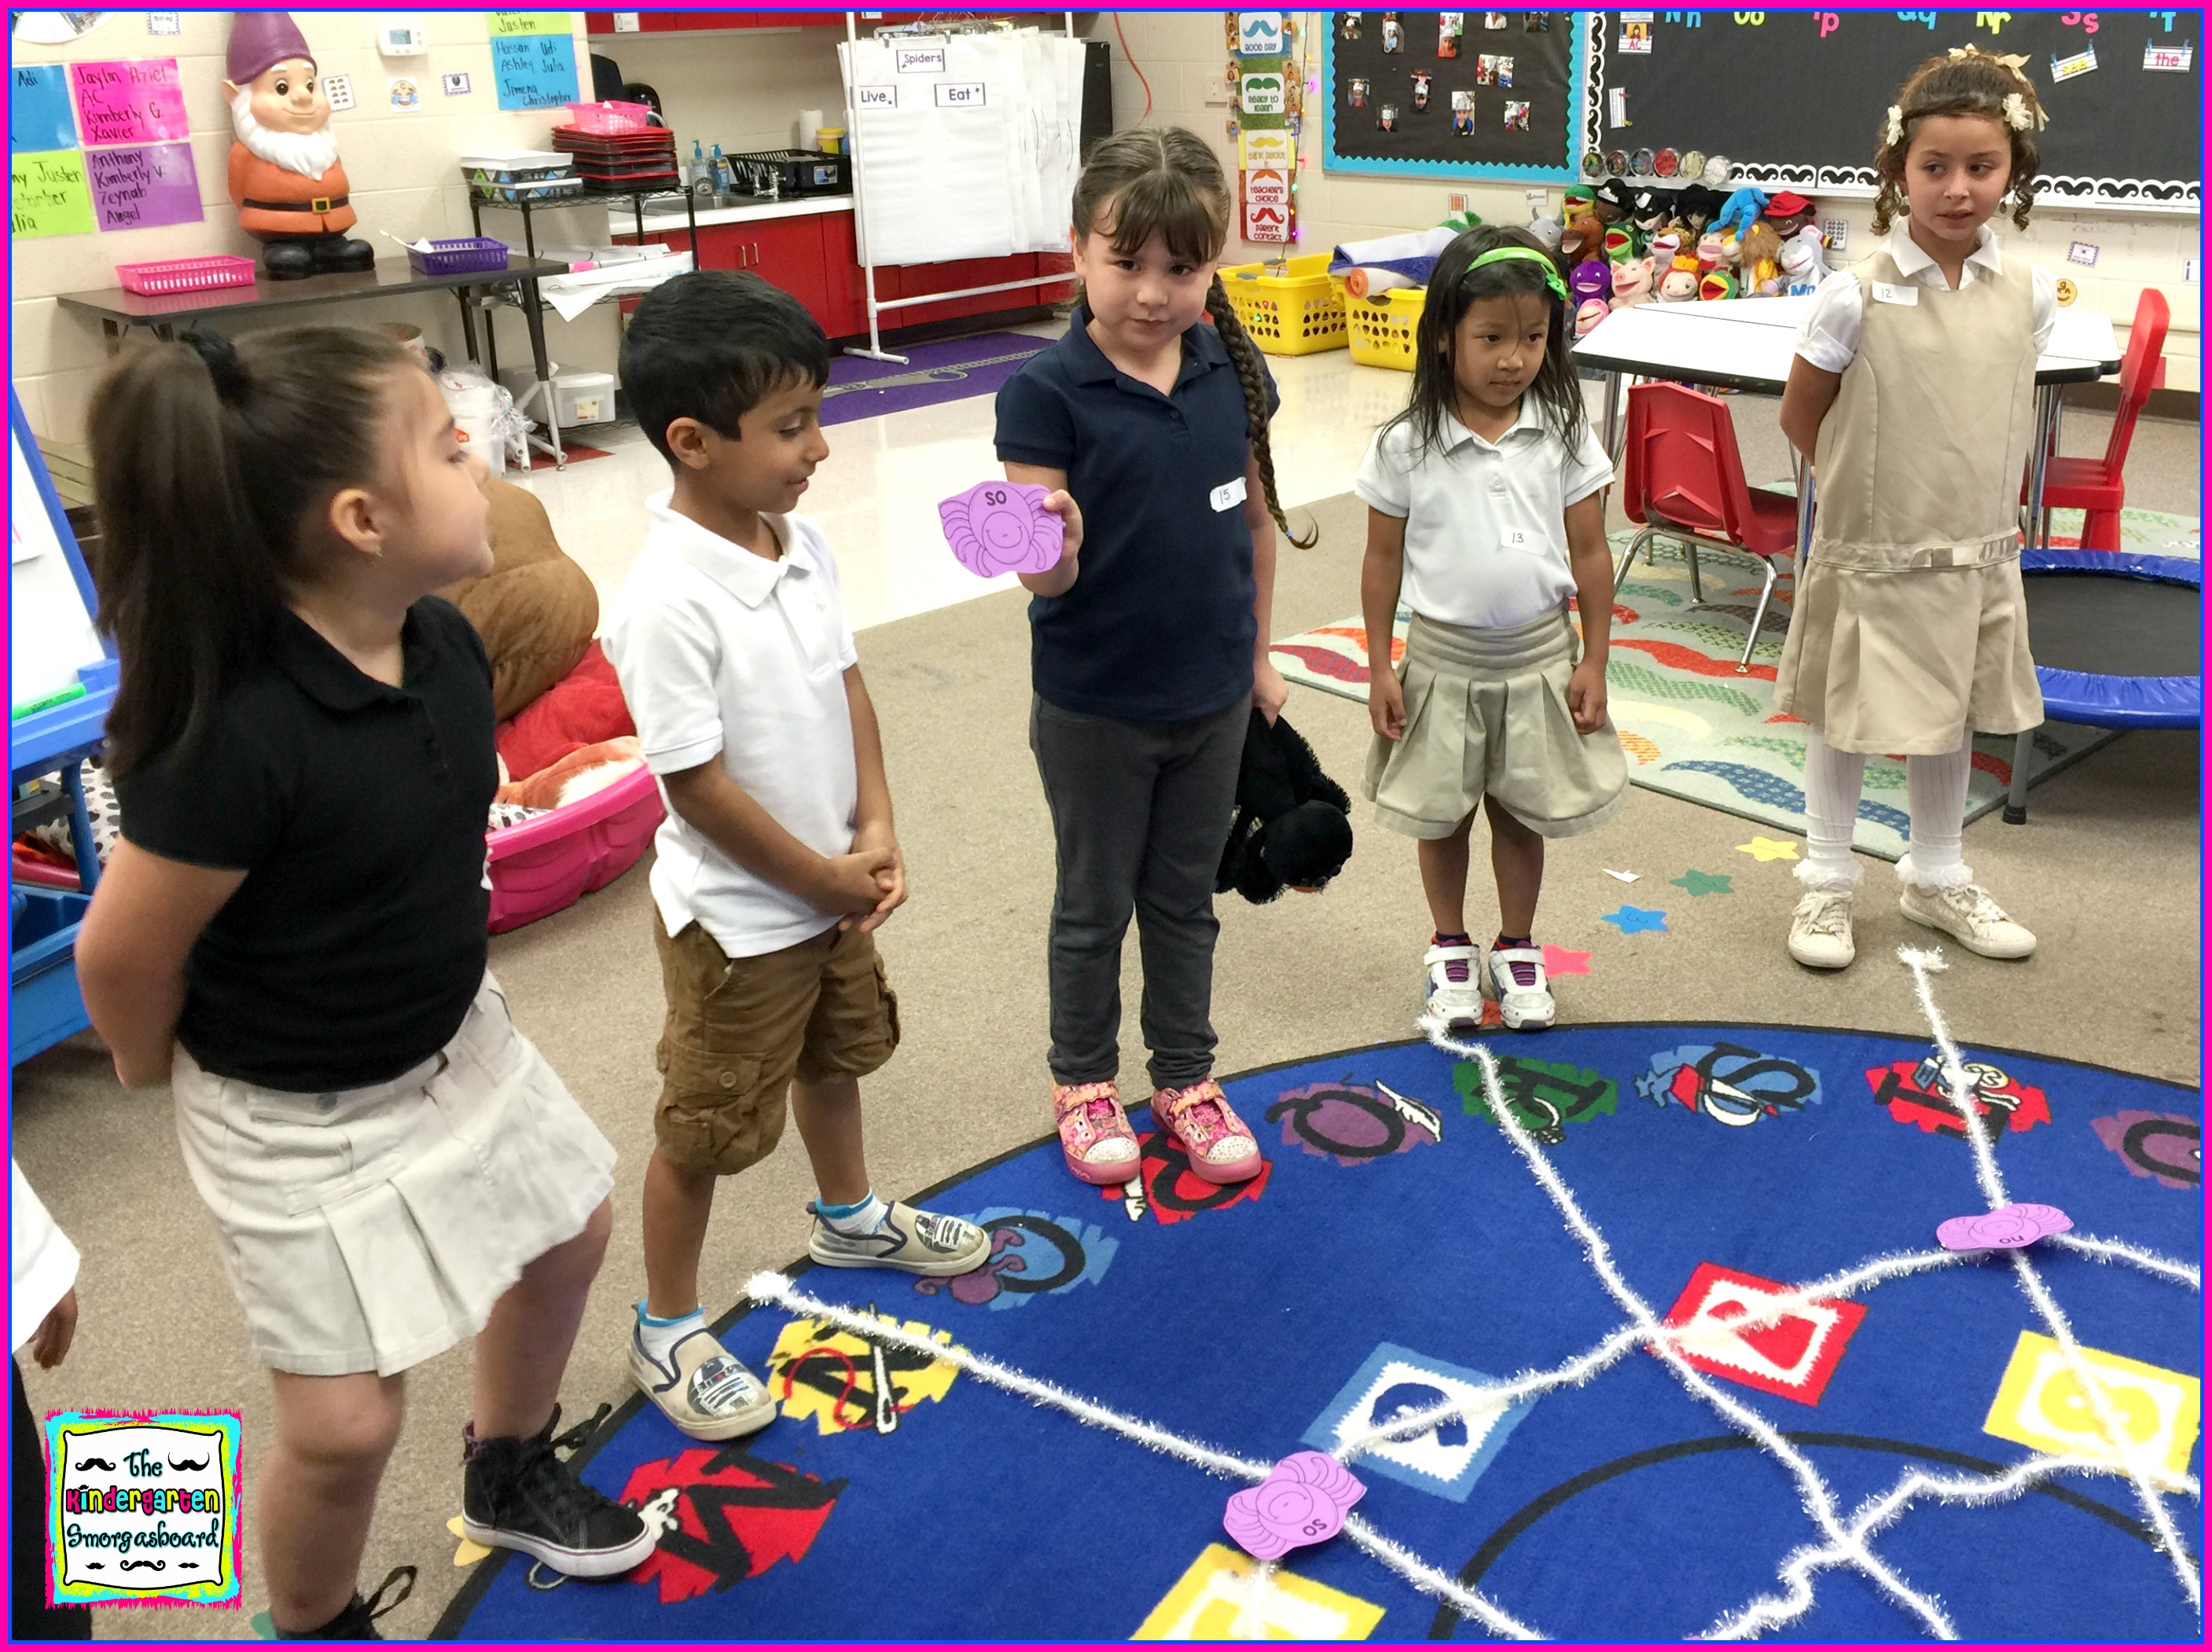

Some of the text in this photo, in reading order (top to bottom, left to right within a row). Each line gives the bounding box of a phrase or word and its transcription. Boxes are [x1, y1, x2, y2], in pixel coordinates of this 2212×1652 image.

[1813, 11, 1839, 38] p
[502, 57, 534, 74] Ashley
[904, 53, 942, 65] Spiders
[2155, 53, 2180, 67] the
[82, 89, 104, 108] AC
[861, 90, 886, 103] Live
[949, 88, 971, 101] Eat
[83, 104, 145, 130] Kimberly
[90, 125, 134, 142] Xavier
[94, 165, 151, 189] Kimberly
[107, 203, 141, 226] Angel
[1881, 288, 1892, 299] 12
[1219, 487, 1231, 505] 15
[1512, 532, 1524, 544] 13
